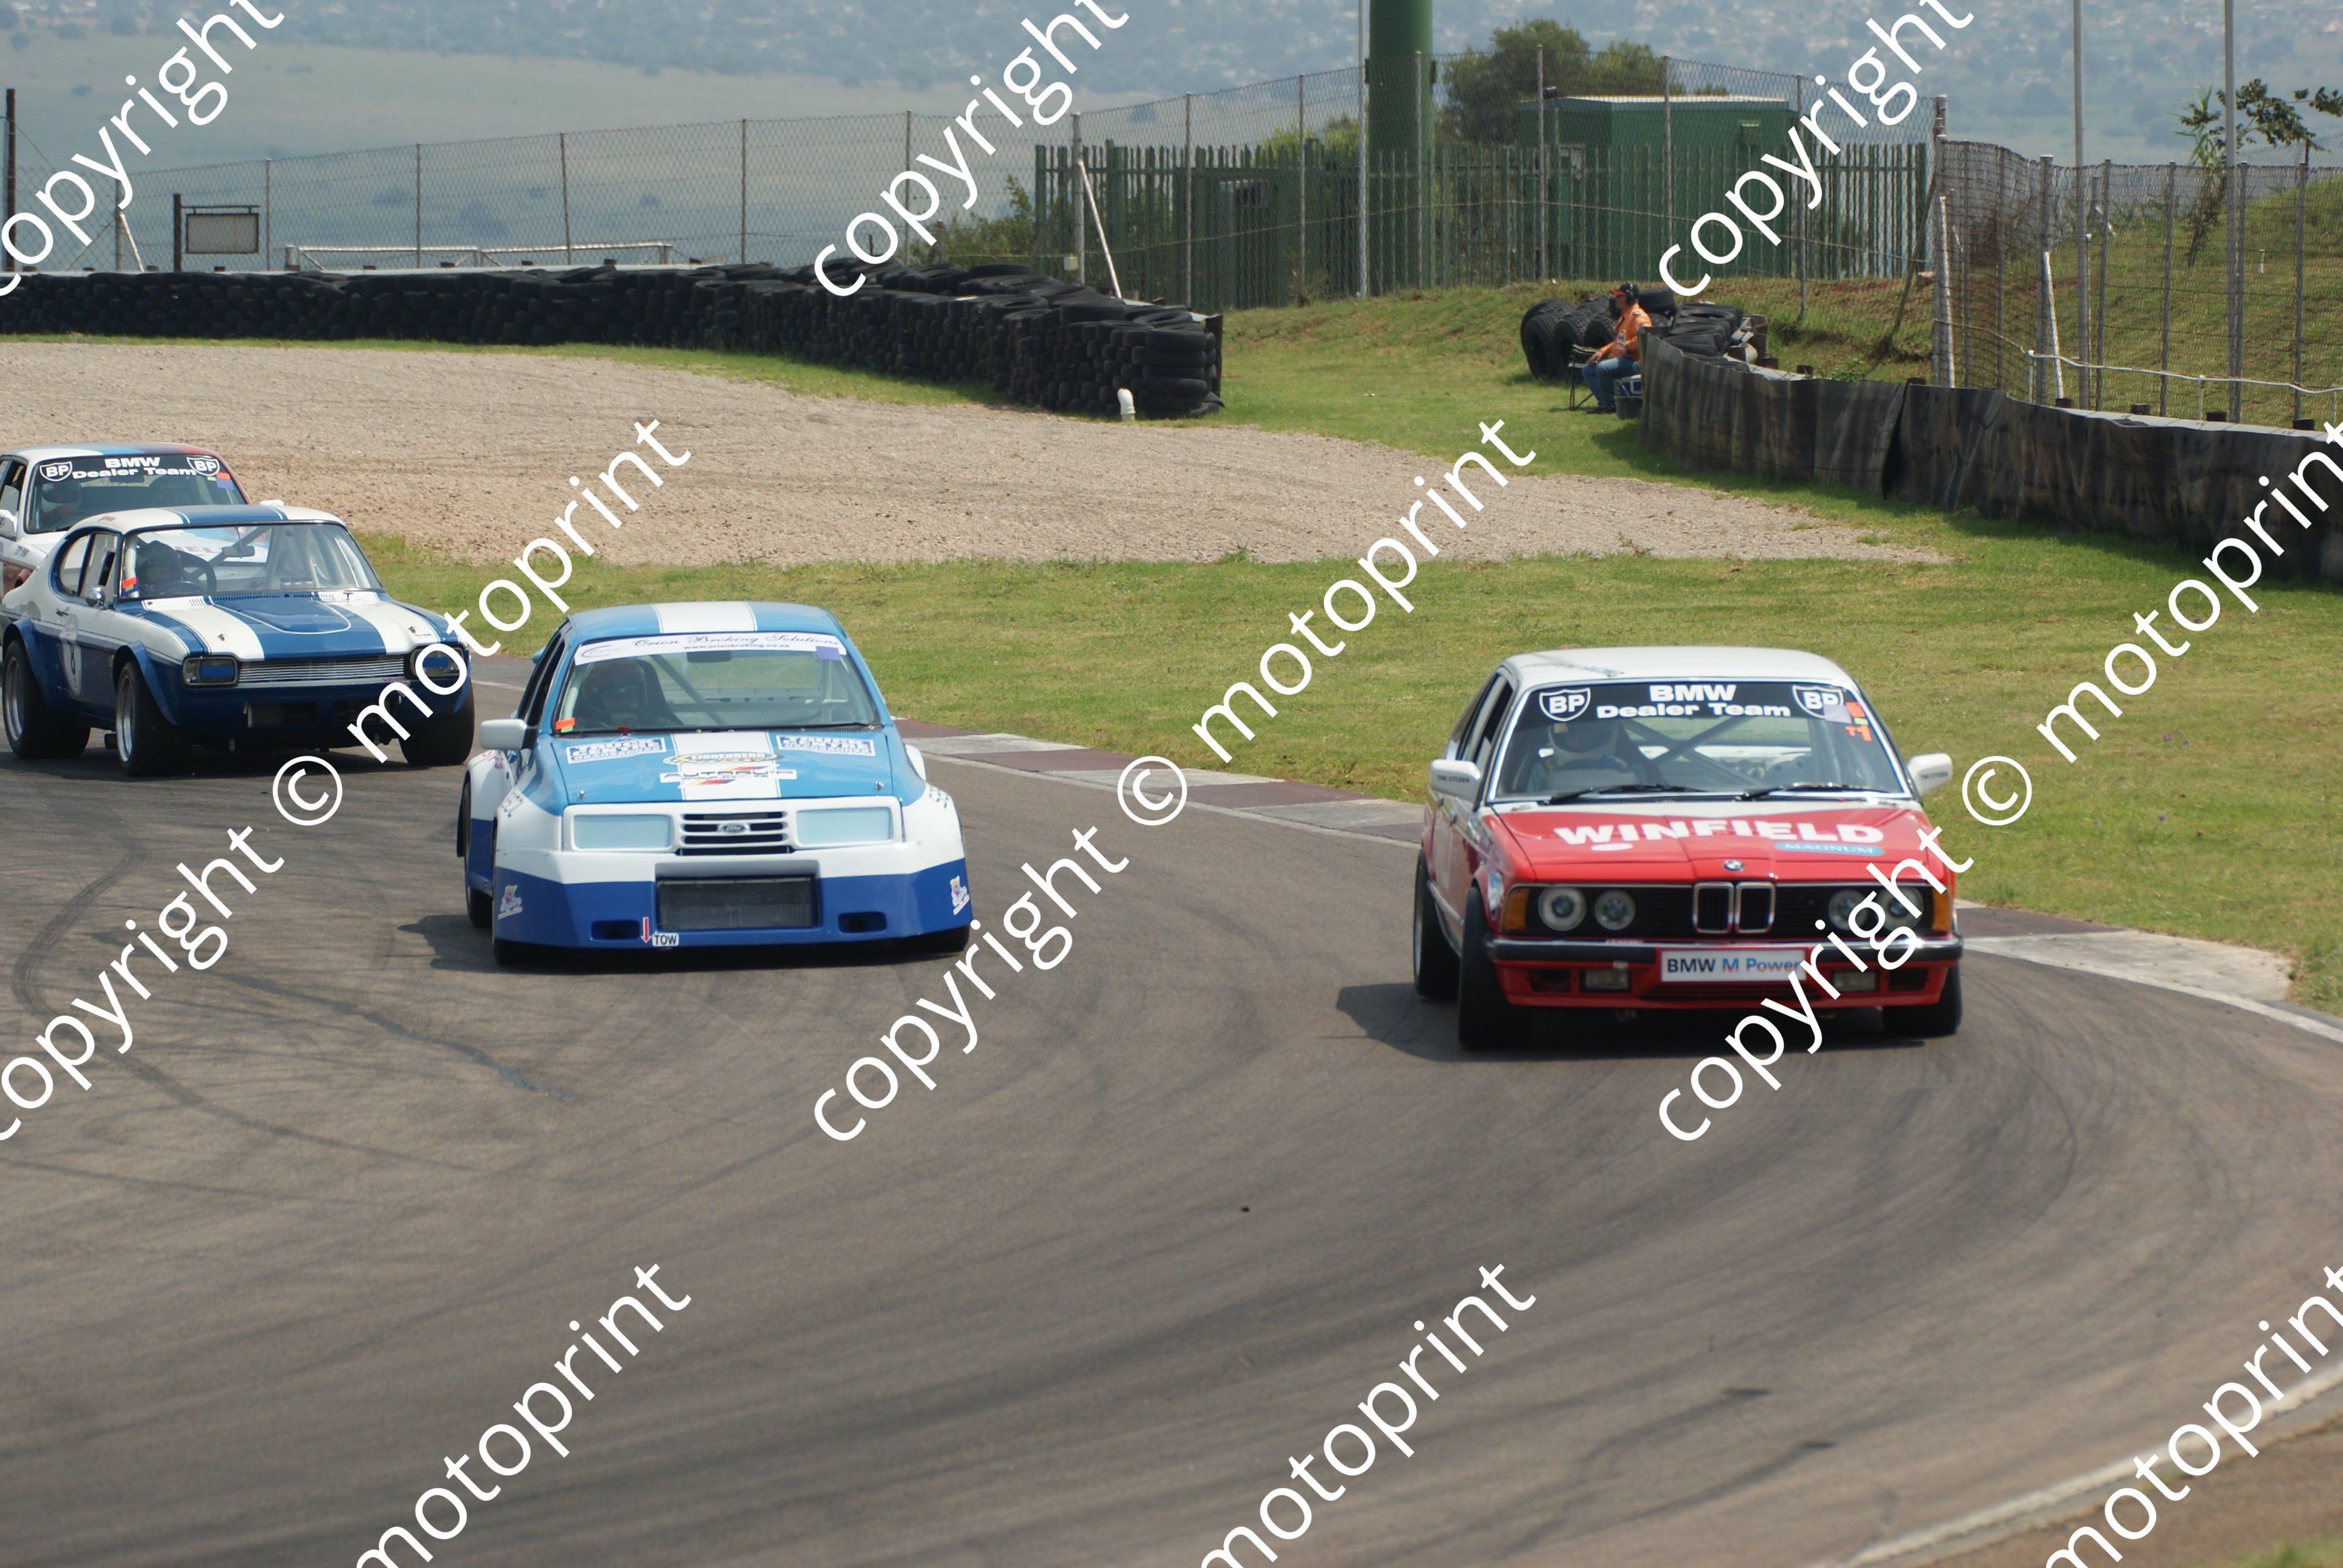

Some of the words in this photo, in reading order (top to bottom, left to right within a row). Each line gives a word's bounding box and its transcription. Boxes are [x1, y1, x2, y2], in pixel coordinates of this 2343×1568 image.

[104, 457, 161, 468] BMW
[194, 459, 217, 472] BP
[46, 465, 69, 477] BP
[72, 468, 139, 479] Dealer
[144, 467, 197, 476] Team
[634, 639, 679, 647] Orion
[687, 635, 759, 645] Broking
[765, 635, 839, 646] Solutions
[1649, 684, 1737, 702] BMW
[1548, 694, 1586, 714] BP
[1596, 704, 1700, 719] Dealer
[1707, 702, 1791, 717] Team
[1554, 819, 1884, 845] WINFIELD
[1784, 843, 1874, 854] MAGNUM
[654, 935, 678, 945] TOW
[1666, 958, 1716, 973] BMW
[1722, 958, 1739, 973] M
[1746, 957, 1801, 972] Power
